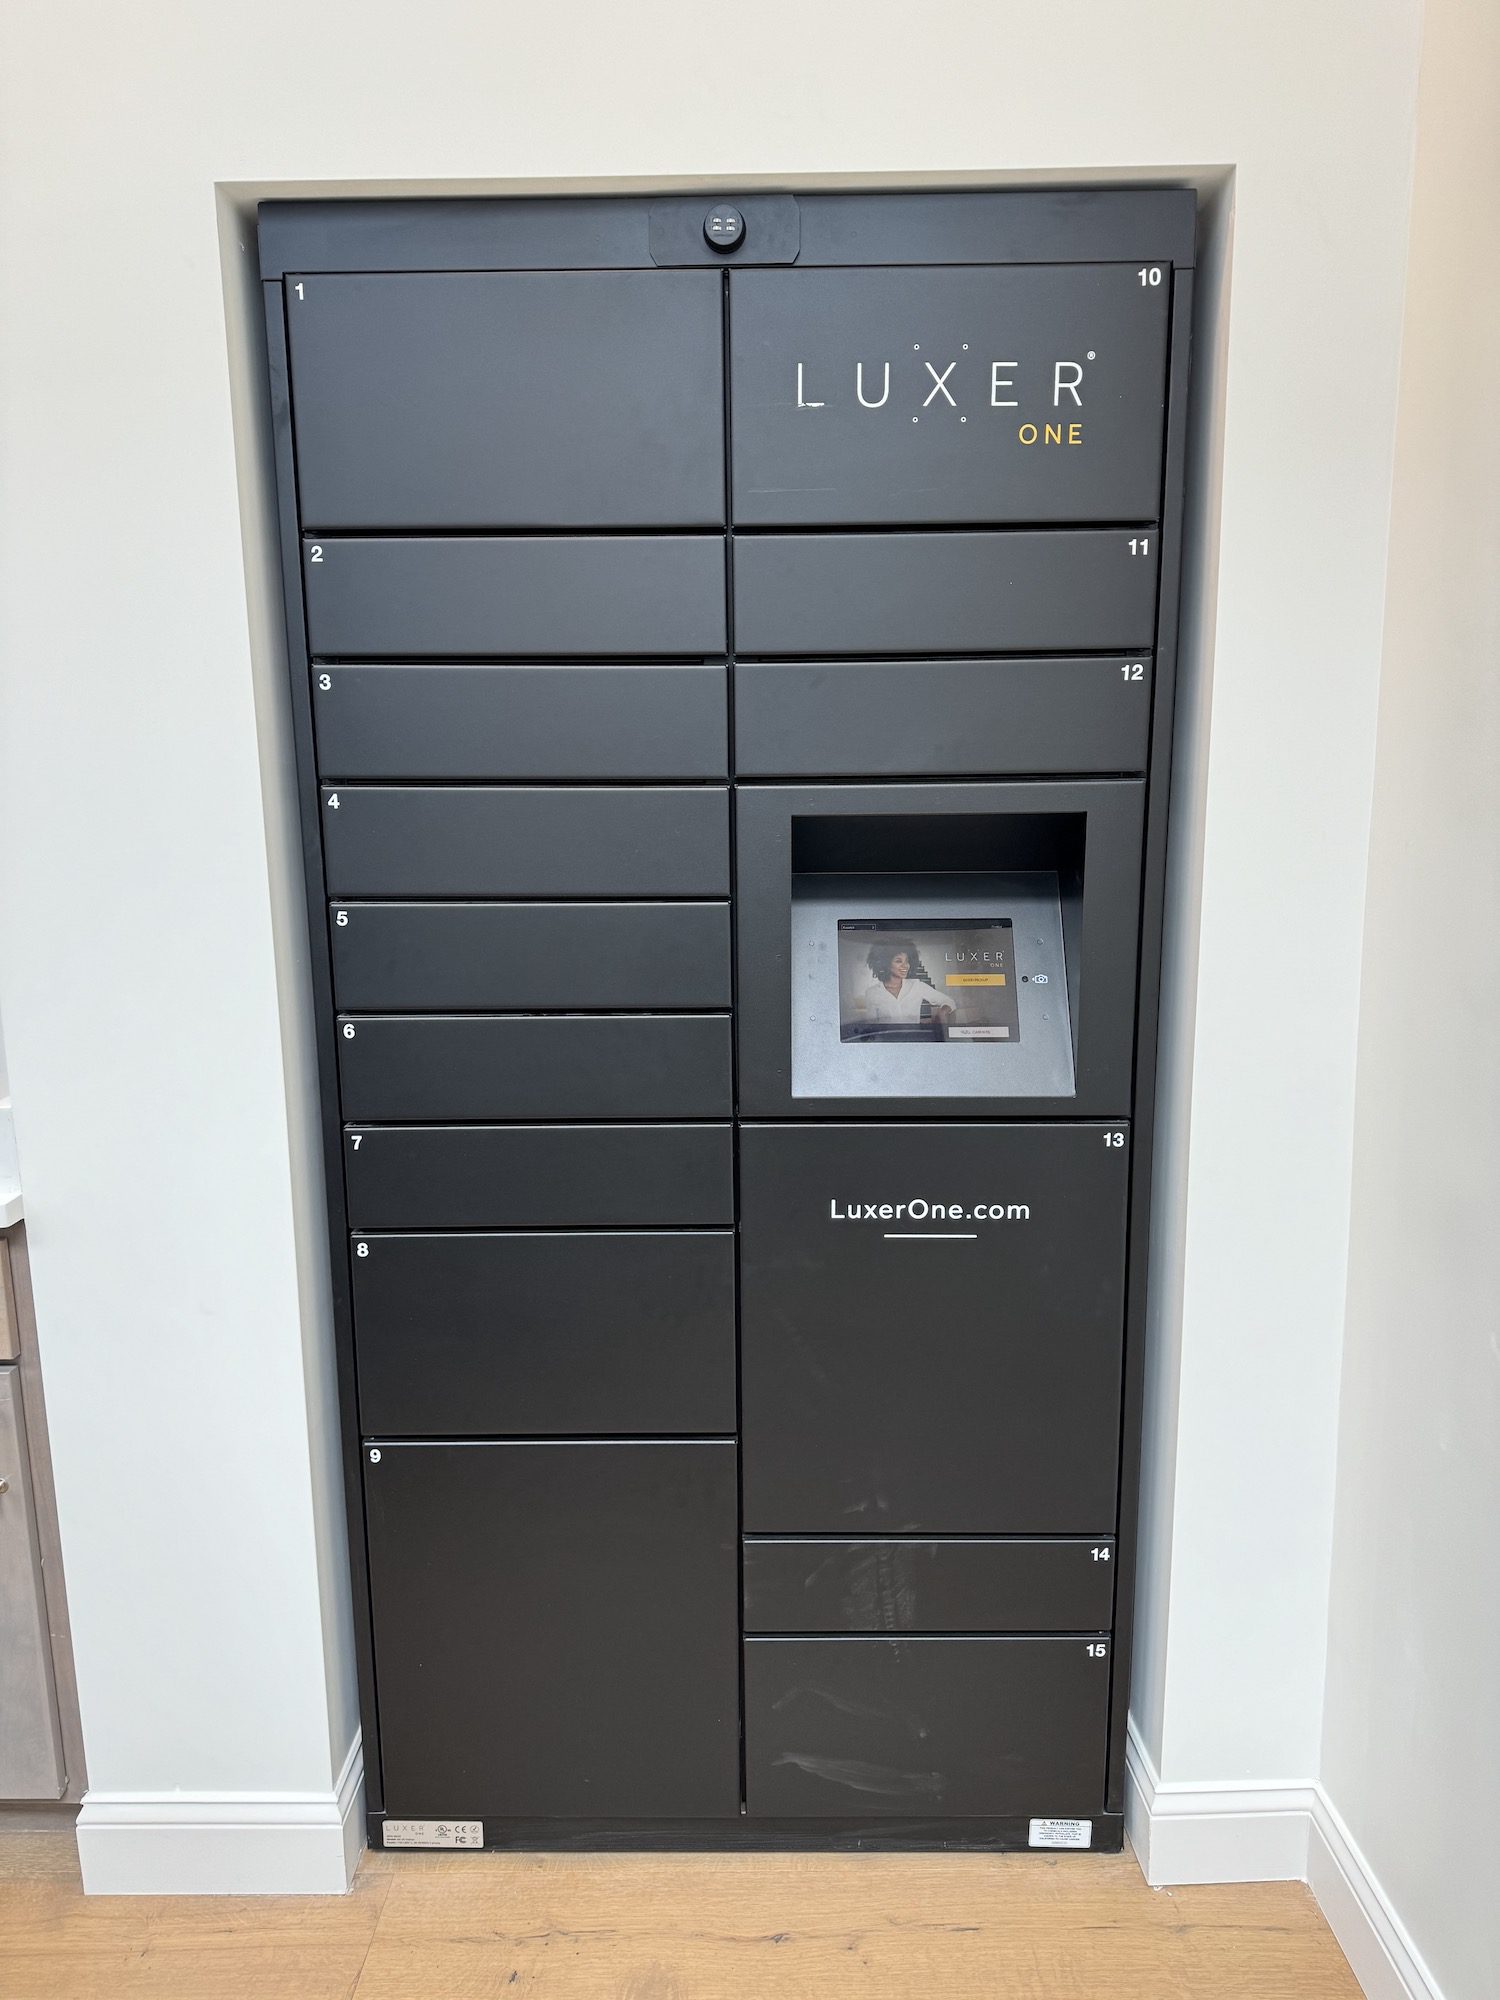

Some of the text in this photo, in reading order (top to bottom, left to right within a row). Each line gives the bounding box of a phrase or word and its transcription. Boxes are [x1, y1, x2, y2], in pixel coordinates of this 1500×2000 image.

[1138, 267, 1162, 287] 10
[294, 282, 304, 301] 1
[1018, 423, 1082, 445] ONE
[310, 545, 324, 563] 2
[1128, 538, 1149, 556] 11
[1121, 663, 1144, 681] 12
[319, 673, 332, 691] 3
[327, 793, 340, 810] 4
[336, 910, 349, 927] 5
[945, 952, 1004, 962] LUXER
[343, 1023, 356, 1039] 6
[351, 1135, 363, 1151] 7
[1103, 1132, 1125, 1148] 13
[830, 1198, 1030, 1220] LuxerOne.com
[356, 1242, 369, 1258] 8
[369, 1448, 382, 1464] 9
[1090, 1547, 1111, 1562] 14
[1086, 1643, 1106, 1658] 15
